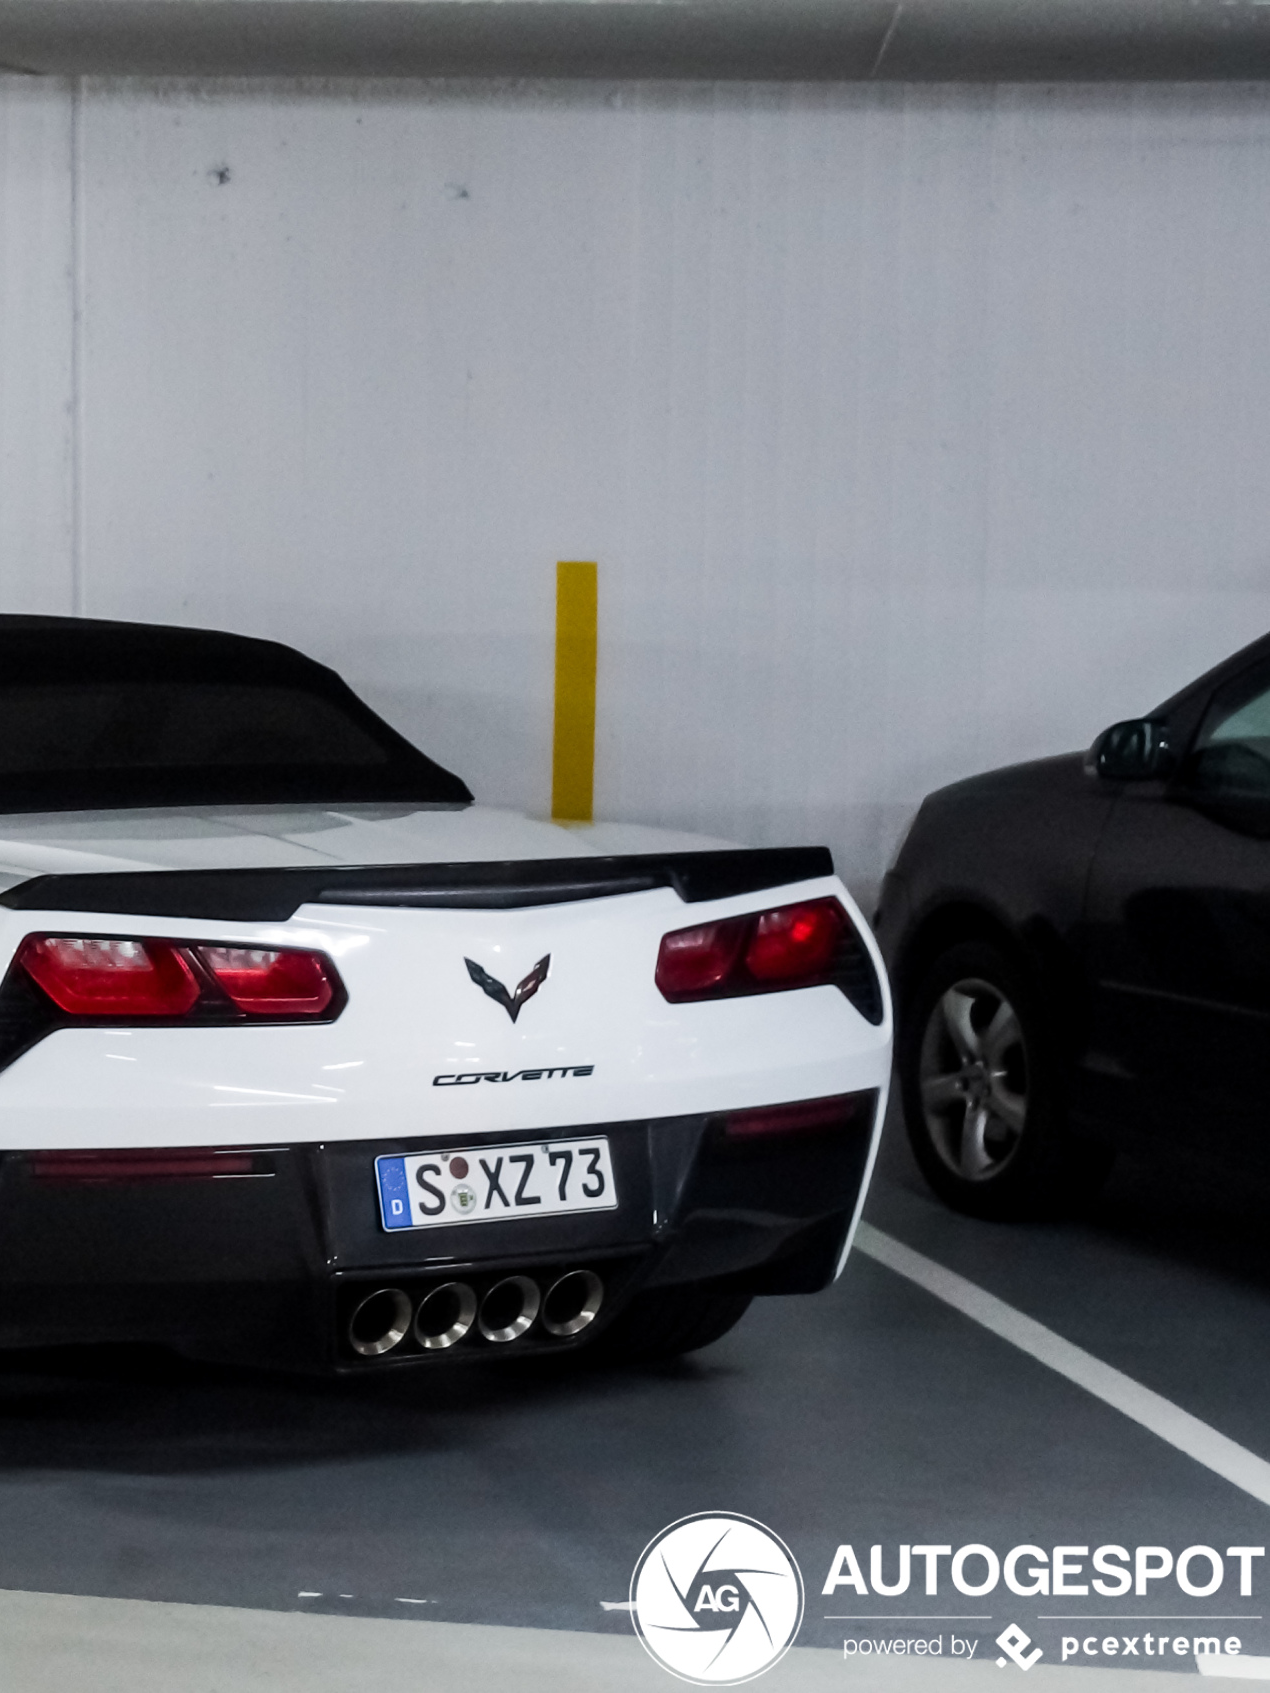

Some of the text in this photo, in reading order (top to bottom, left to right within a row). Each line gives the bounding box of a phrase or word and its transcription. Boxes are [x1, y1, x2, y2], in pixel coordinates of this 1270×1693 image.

[432, 1064, 595, 1087] CORVETTE
[415, 1147, 606, 1216] S XZ 73
[391, 1199, 404, 1216] D
